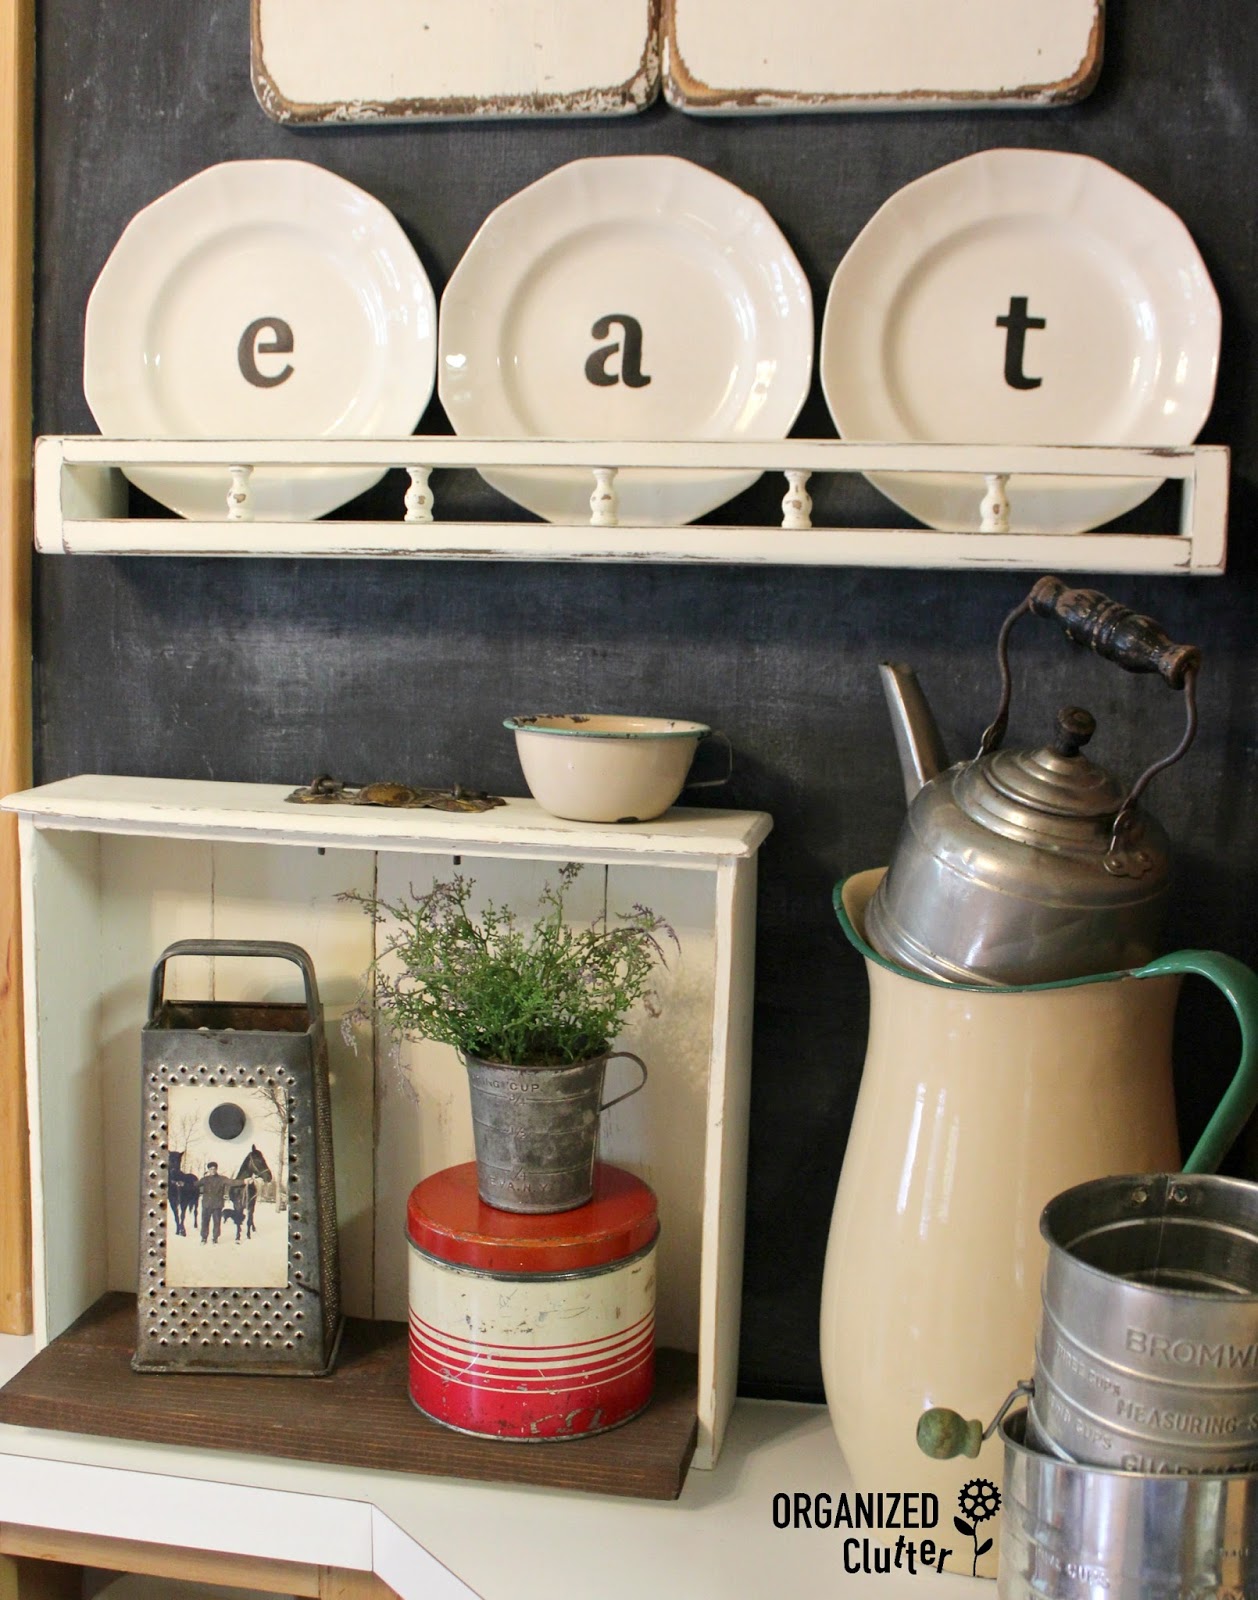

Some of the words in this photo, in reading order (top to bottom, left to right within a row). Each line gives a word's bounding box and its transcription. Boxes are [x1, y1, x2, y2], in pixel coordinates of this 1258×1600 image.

[240, 317, 294, 388] e
[586, 314, 651, 389] a
[996, 297, 1046, 390] t
[509, 1082, 540, 1093] CUP
